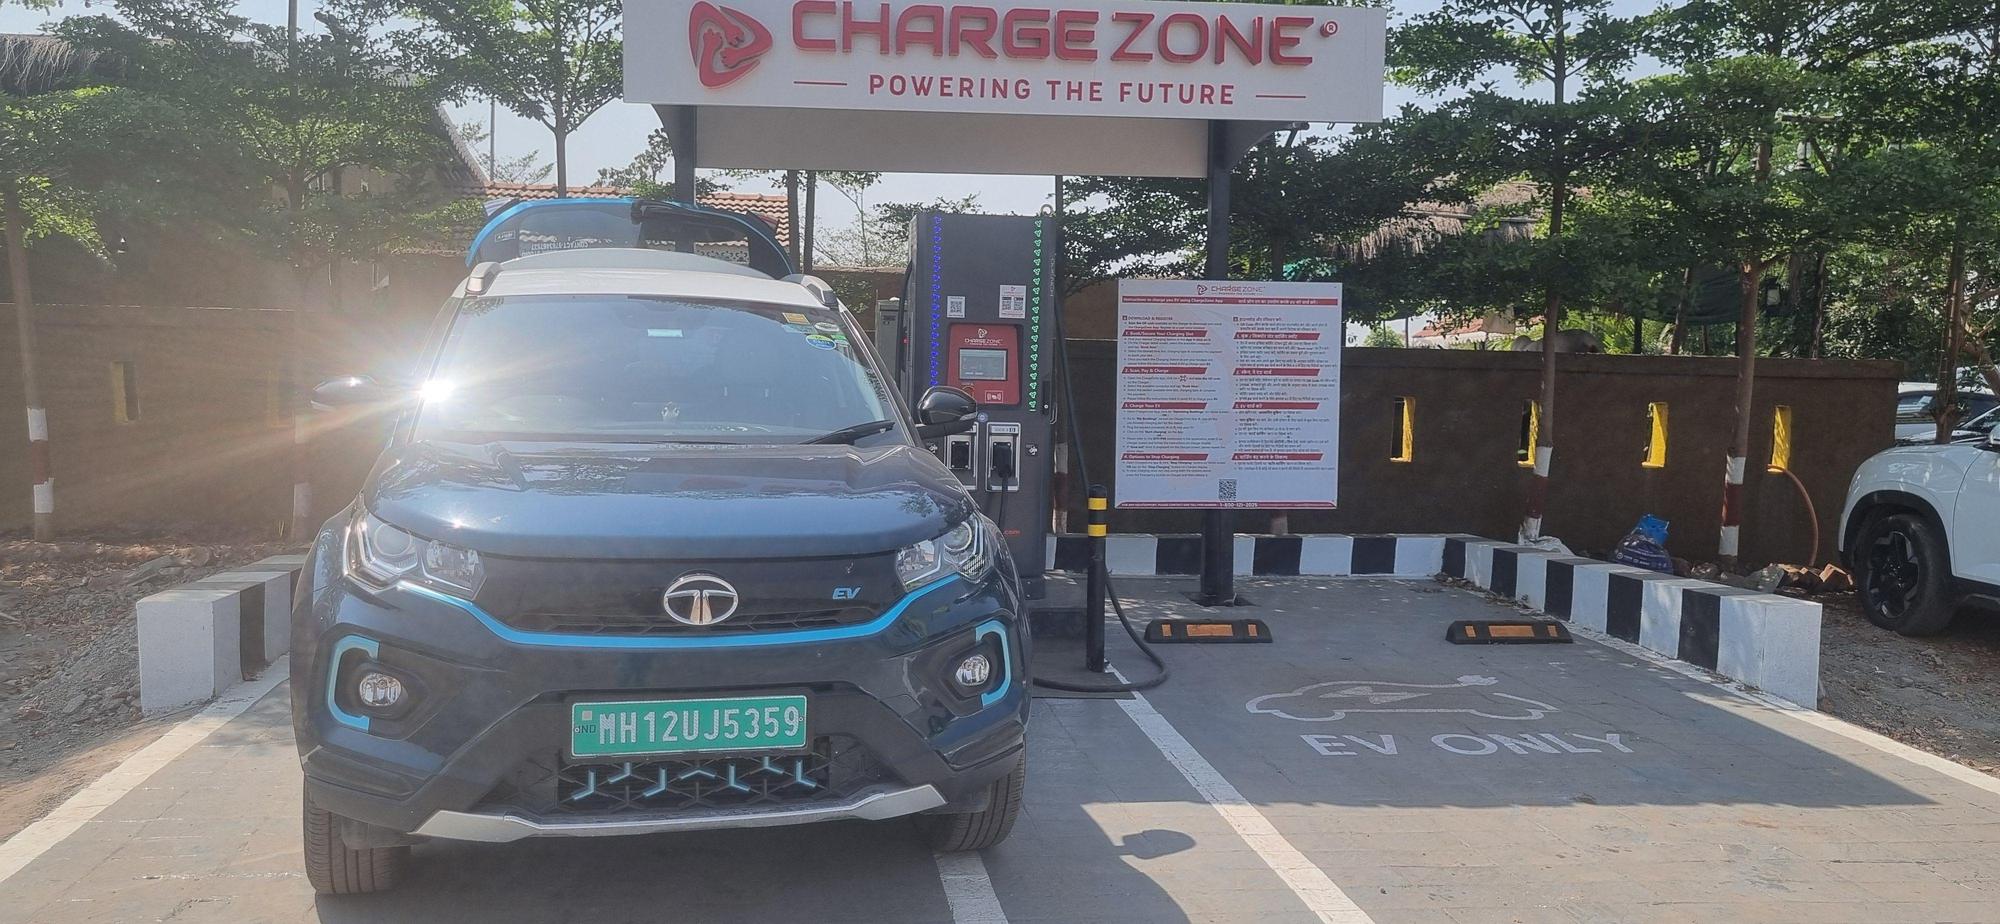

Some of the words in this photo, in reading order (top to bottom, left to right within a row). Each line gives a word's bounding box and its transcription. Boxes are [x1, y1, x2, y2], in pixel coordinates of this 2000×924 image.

[869, 74, 1031, 100] POWERING
[1046, 80, 1102, 102] THE
[1119, 82, 1234, 105] FUTURE
[832, 587, 862, 600] EV
[578, 724, 597, 734] IND
[598, 705, 799, 746] MH12UJ5359
[1300, 733, 1399, 756] EV
[1430, 732, 1635, 755] ONLY
